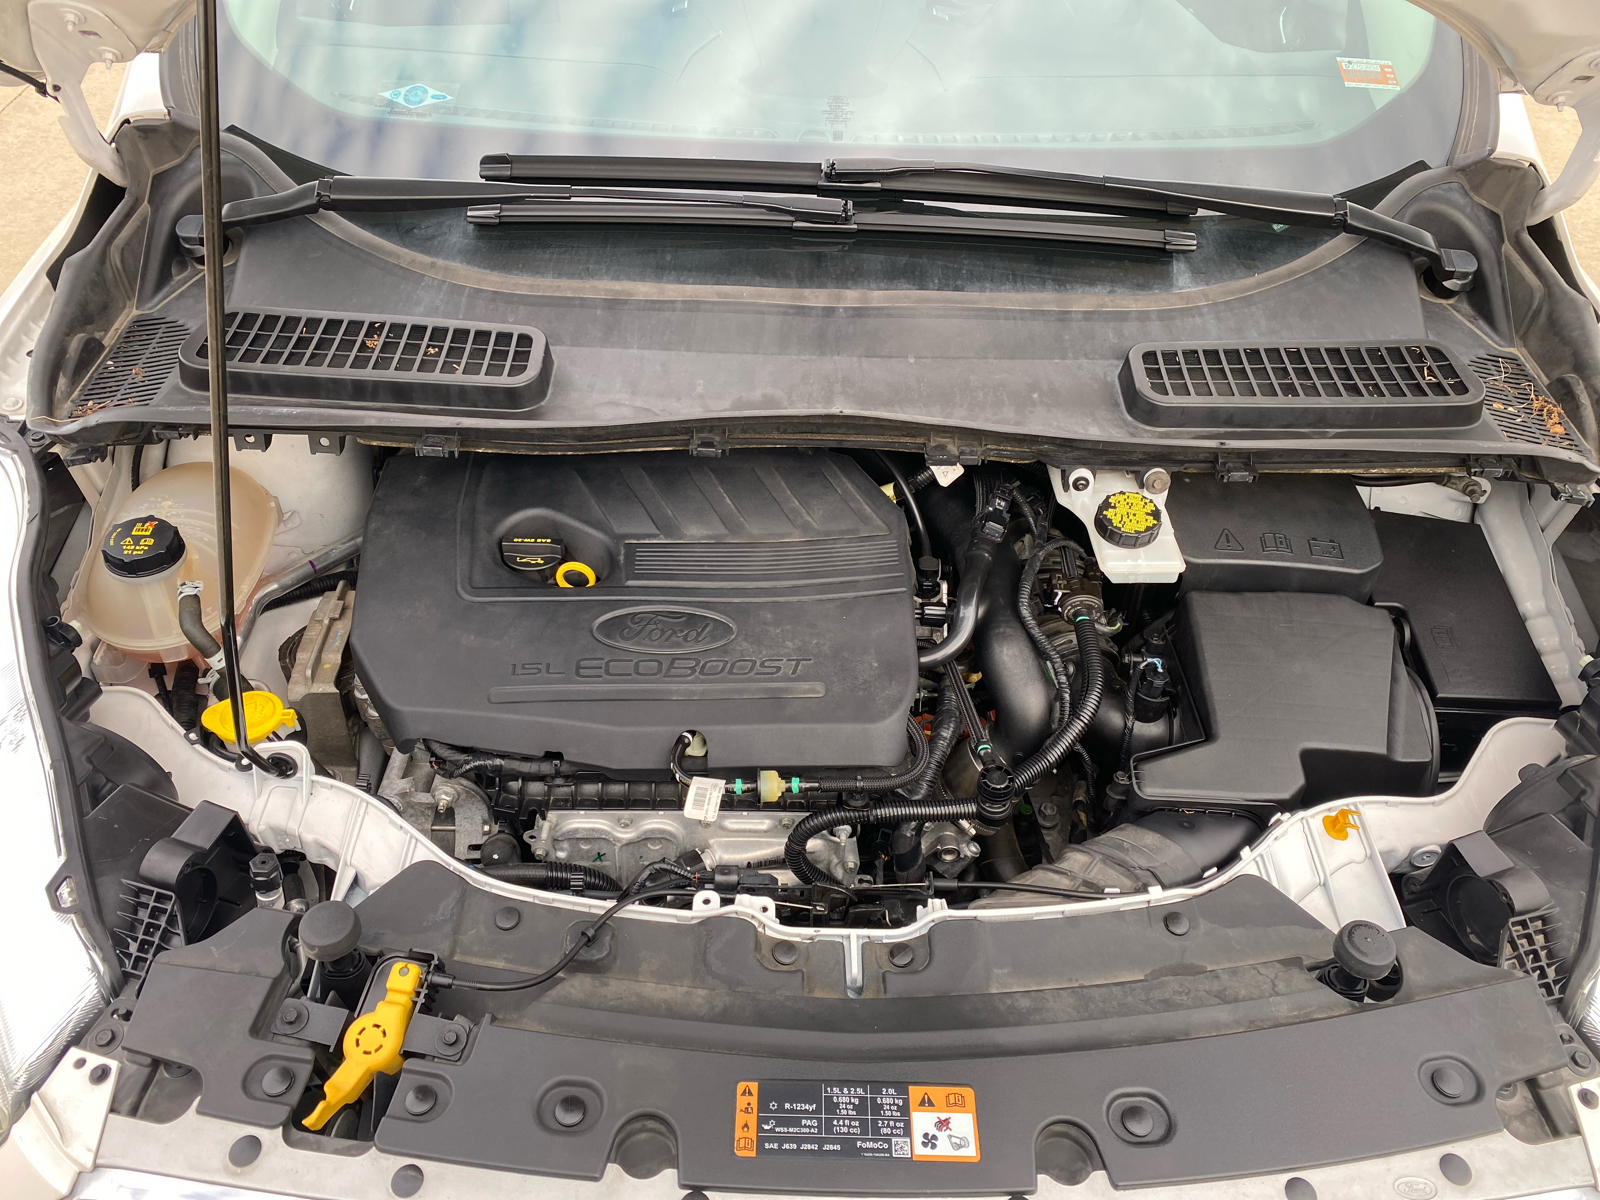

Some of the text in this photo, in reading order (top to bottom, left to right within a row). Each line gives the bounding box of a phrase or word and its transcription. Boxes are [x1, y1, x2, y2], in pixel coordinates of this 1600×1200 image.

[618, 612, 712, 645] Ford
[510, 662, 566, 677] 1.5L
[850, 1097, 859, 1105] kg
[894, 1098, 903, 1106] kg
[784, 1102, 817, 1112] R-1234yf
[849, 1127, 860, 1135] cc)
[892, 1128, 904, 1136] cc)
[764, 1142, 779, 1150] SAE
[800, 1143, 819, 1151] J2842
[856, 1141, 889, 1149] FoMoCo
